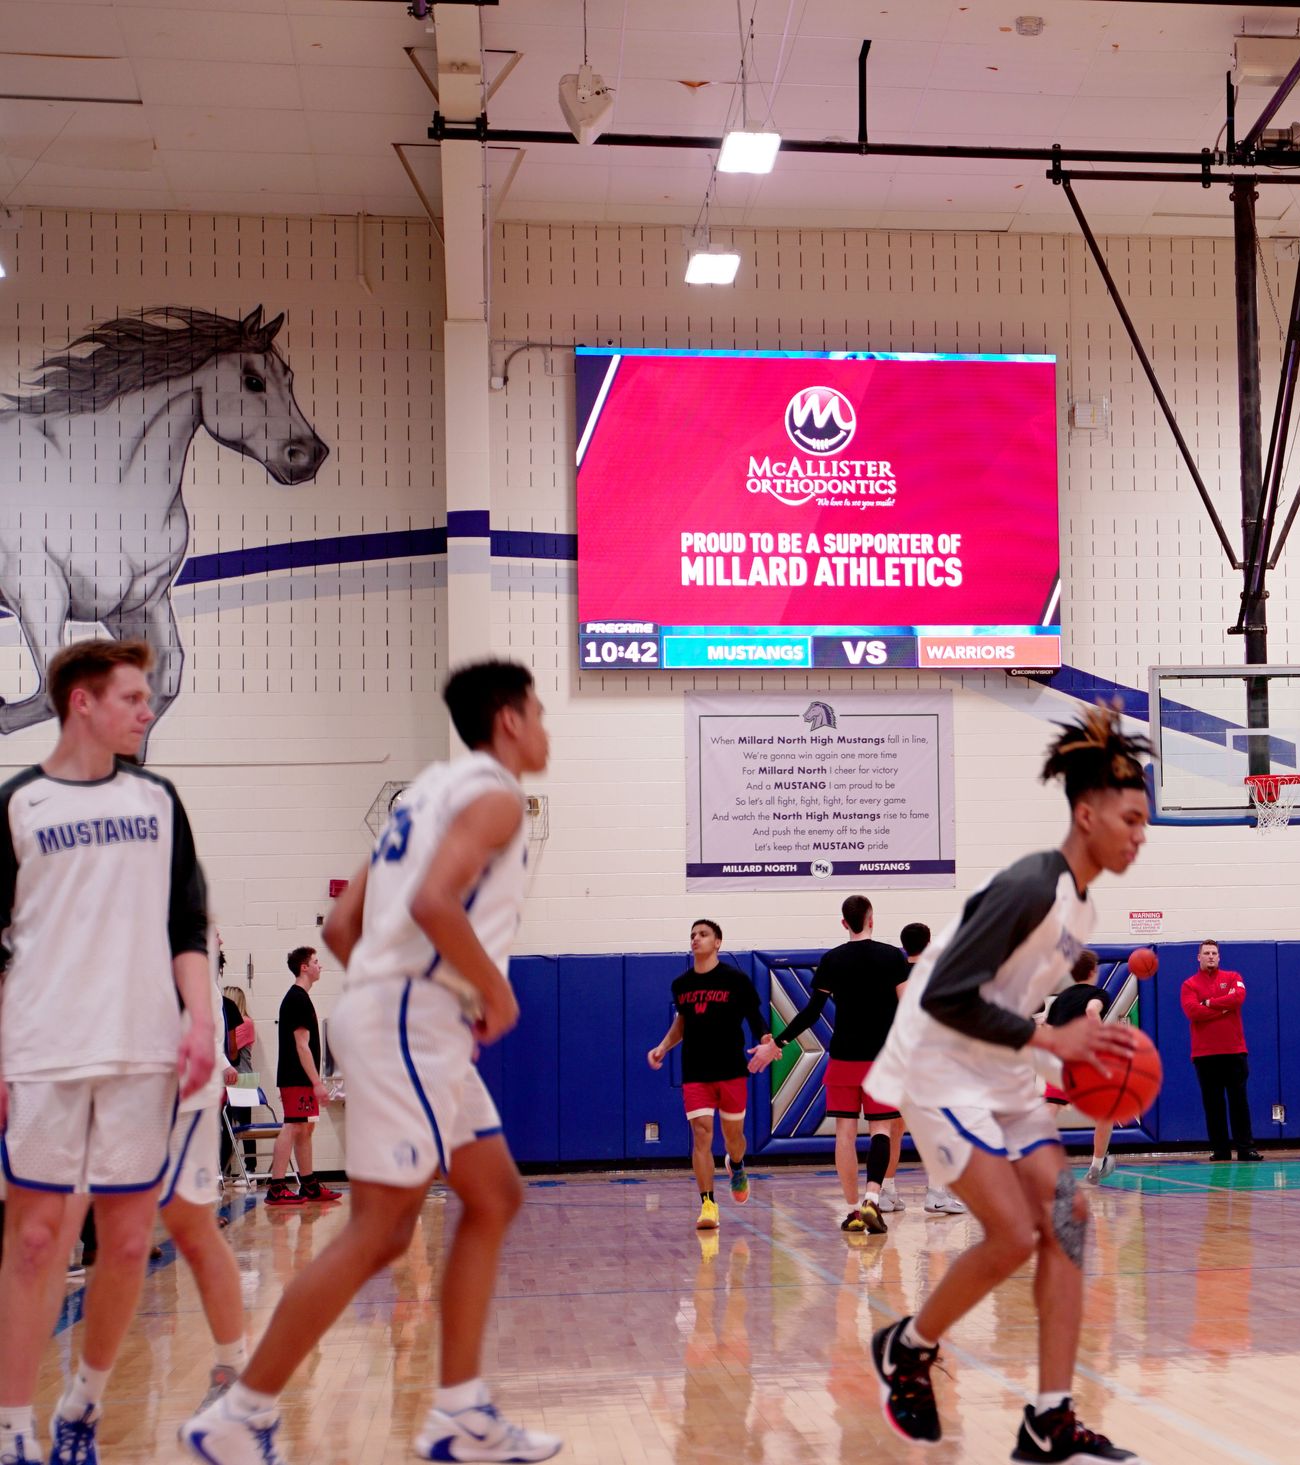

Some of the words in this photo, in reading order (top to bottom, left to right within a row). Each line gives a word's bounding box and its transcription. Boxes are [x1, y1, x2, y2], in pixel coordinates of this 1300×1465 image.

[746, 478, 897, 502] ORTHODONTICS
[680, 532, 746, 553] PROUD
[749, 533, 774, 553] TO
[778, 533, 802, 554] BE
[805, 533, 820, 554] A
[823, 533, 934, 554] SUPPORTER
[938, 534, 961, 554] OF
[681, 556, 808, 586] MILLARD
[813, 556, 962, 587] ATHLETICS
[586, 623, 654, 633] PREGAME
[584, 641, 658, 663] 10:42
[707, 645, 804, 661] MUSTANGS
[842, 640, 888, 665] VS
[926, 645, 1015, 660] WARRIORS
[711, 736, 736, 744] When
[738, 736, 774, 744] Millard
[777, 736, 807, 744] North
[810, 736, 833, 746] High
[837, 736, 885, 746] Mustangs
[887, 735, 900, 744] fall
[902, 735, 910, 744] in
[743, 752, 768, 760] We're
[770, 754, 796, 762] gonna
[798, 752, 813, 760] win
[815, 752, 838, 761] again
[881, 751, 897, 759] time
[742, 766, 756, 775] For
[758, 766, 794, 775] Millard
[797, 766, 827, 775] North
[834, 765, 856, 775] cheer
[858, 765, 869, 774] for
[871, 766, 898, 776] victory
[746, 782, 763, 791] And
[774, 781, 826, 790] MUSTANG
[849, 780, 873, 791] proud
[875, 781, 883, 789] to
[885, 780, 895, 789] be
[735, 797, 746, 806] So
[748, 797, 763, 806] let's
[765, 796, 775, 806] all
[777, 796, 798, 807] fight,
[800, 796, 821, 807] fight,
[823, 796, 844, 807] fight,
[846, 795, 857, 805] for
[859, 798, 880, 806] every
[883, 798, 906, 806] game
[712, 812, 730, 821] And
[732, 812, 755, 821] watch
[758, 812, 770, 821] the
[772, 812, 803, 820] North
[806, 812, 829, 822] High
[832, 812, 881, 821] Mustangs
[883, 810, 897, 819] rise
[900, 811, 908, 819] to
[909, 810, 929, 819] fame
[32, 814, 160, 857] MUSTANGS
[752, 828, 770, 836] And
[772, 827, 791, 837] push
[793, 827, 806, 836] the
[808, 828, 834, 837] enemy
[836, 826, 848, 835] off
[849, 826, 858, 835] to
[859, 826, 872, 834] the
[874, 825, 890, 834] side
[754, 842, 771, 851] Let's
[773, 842, 793, 853] keep
[794, 841, 810, 851] that
[812, 841, 865, 850] MUSTANG
[867, 841, 888, 851] pride
[722, 864, 762, 873] MILLARD
[764, 864, 797, 872] NORTH
[859, 862, 911, 871] MUSTANGS
